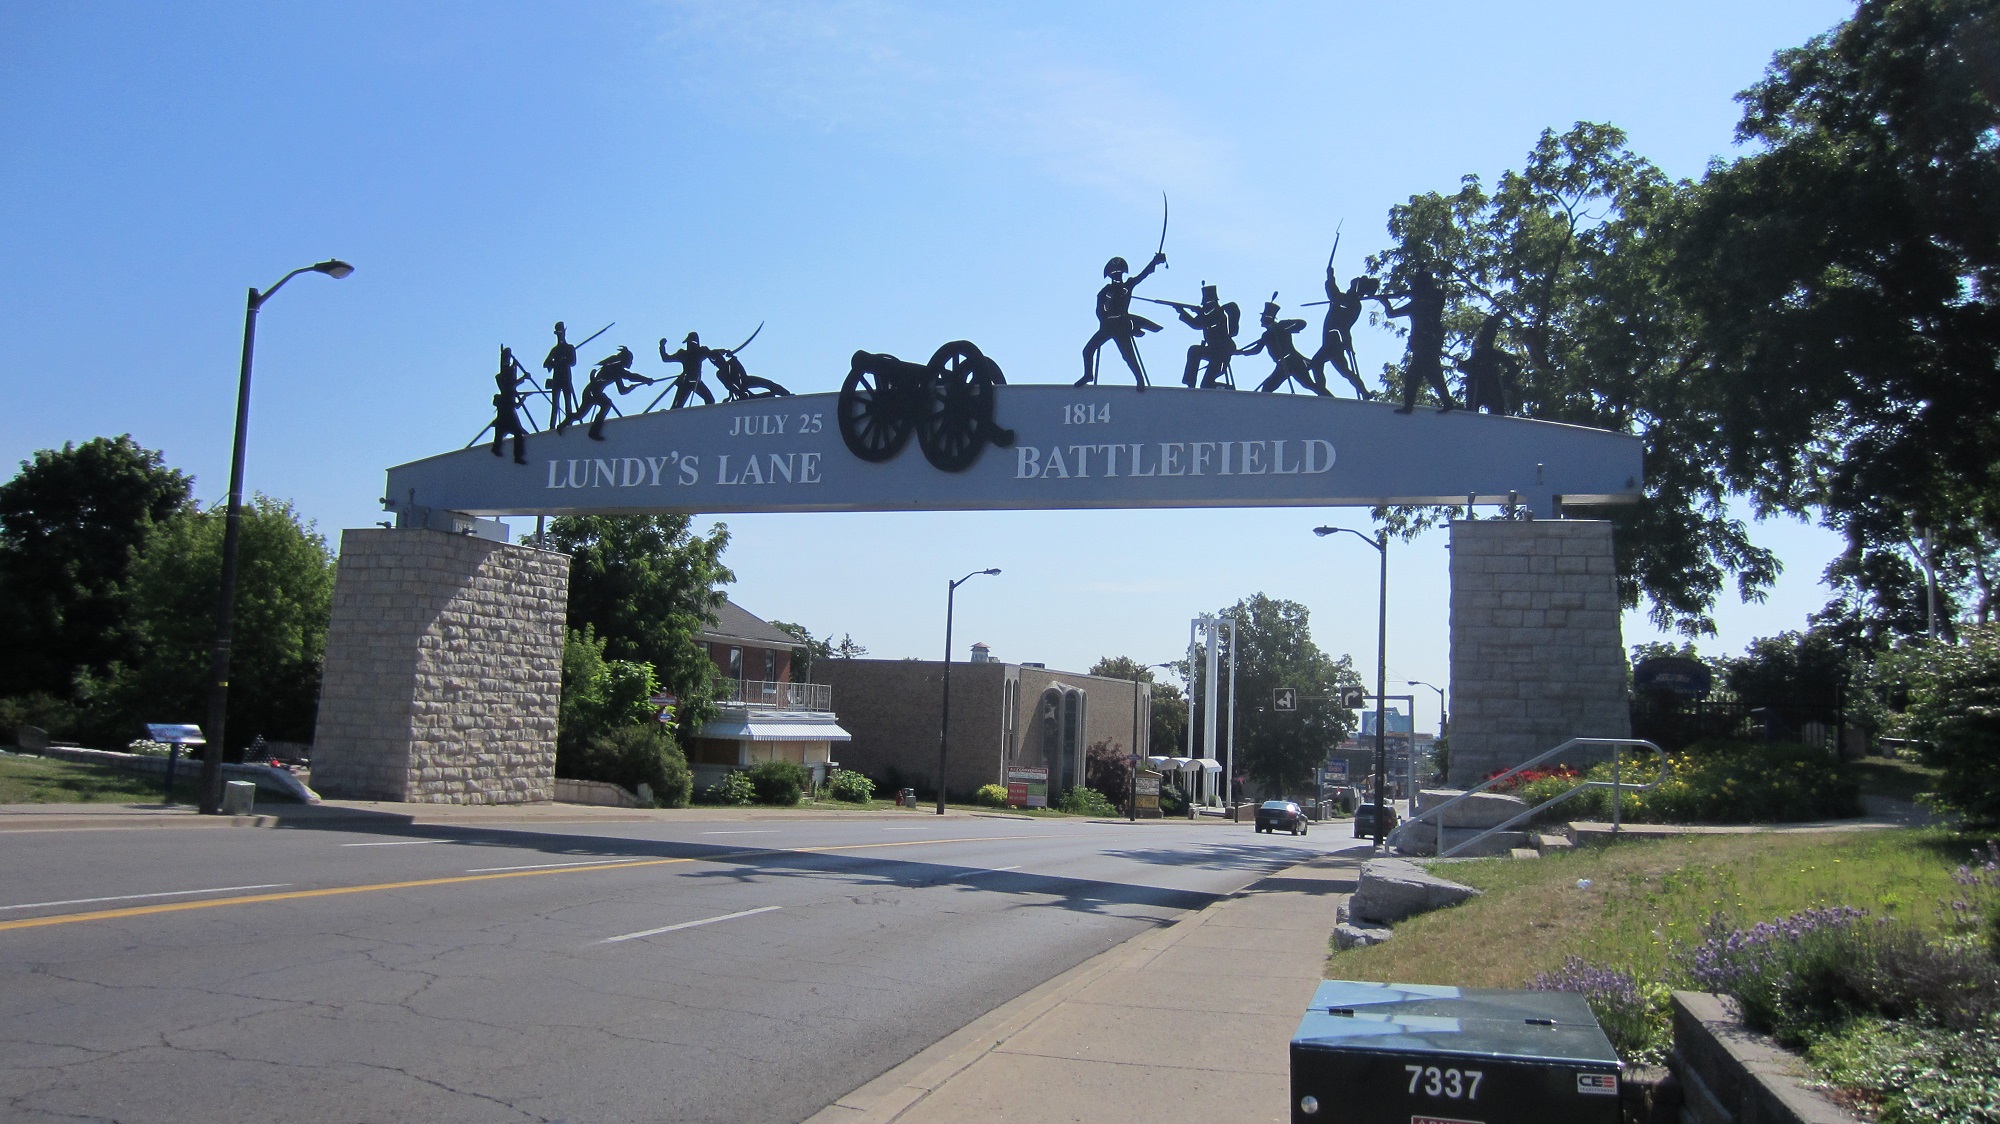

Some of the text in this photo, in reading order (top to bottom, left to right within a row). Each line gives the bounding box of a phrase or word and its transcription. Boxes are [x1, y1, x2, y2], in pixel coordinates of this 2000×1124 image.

[729, 413, 823, 436] JULY 25
[1063, 402, 1111, 425] 1814
[546, 450, 822, 490] LUNDY'S LANE
[1013, 439, 1337, 479] BATTLEFIELD
[1405, 1065, 1483, 1100] 7337
